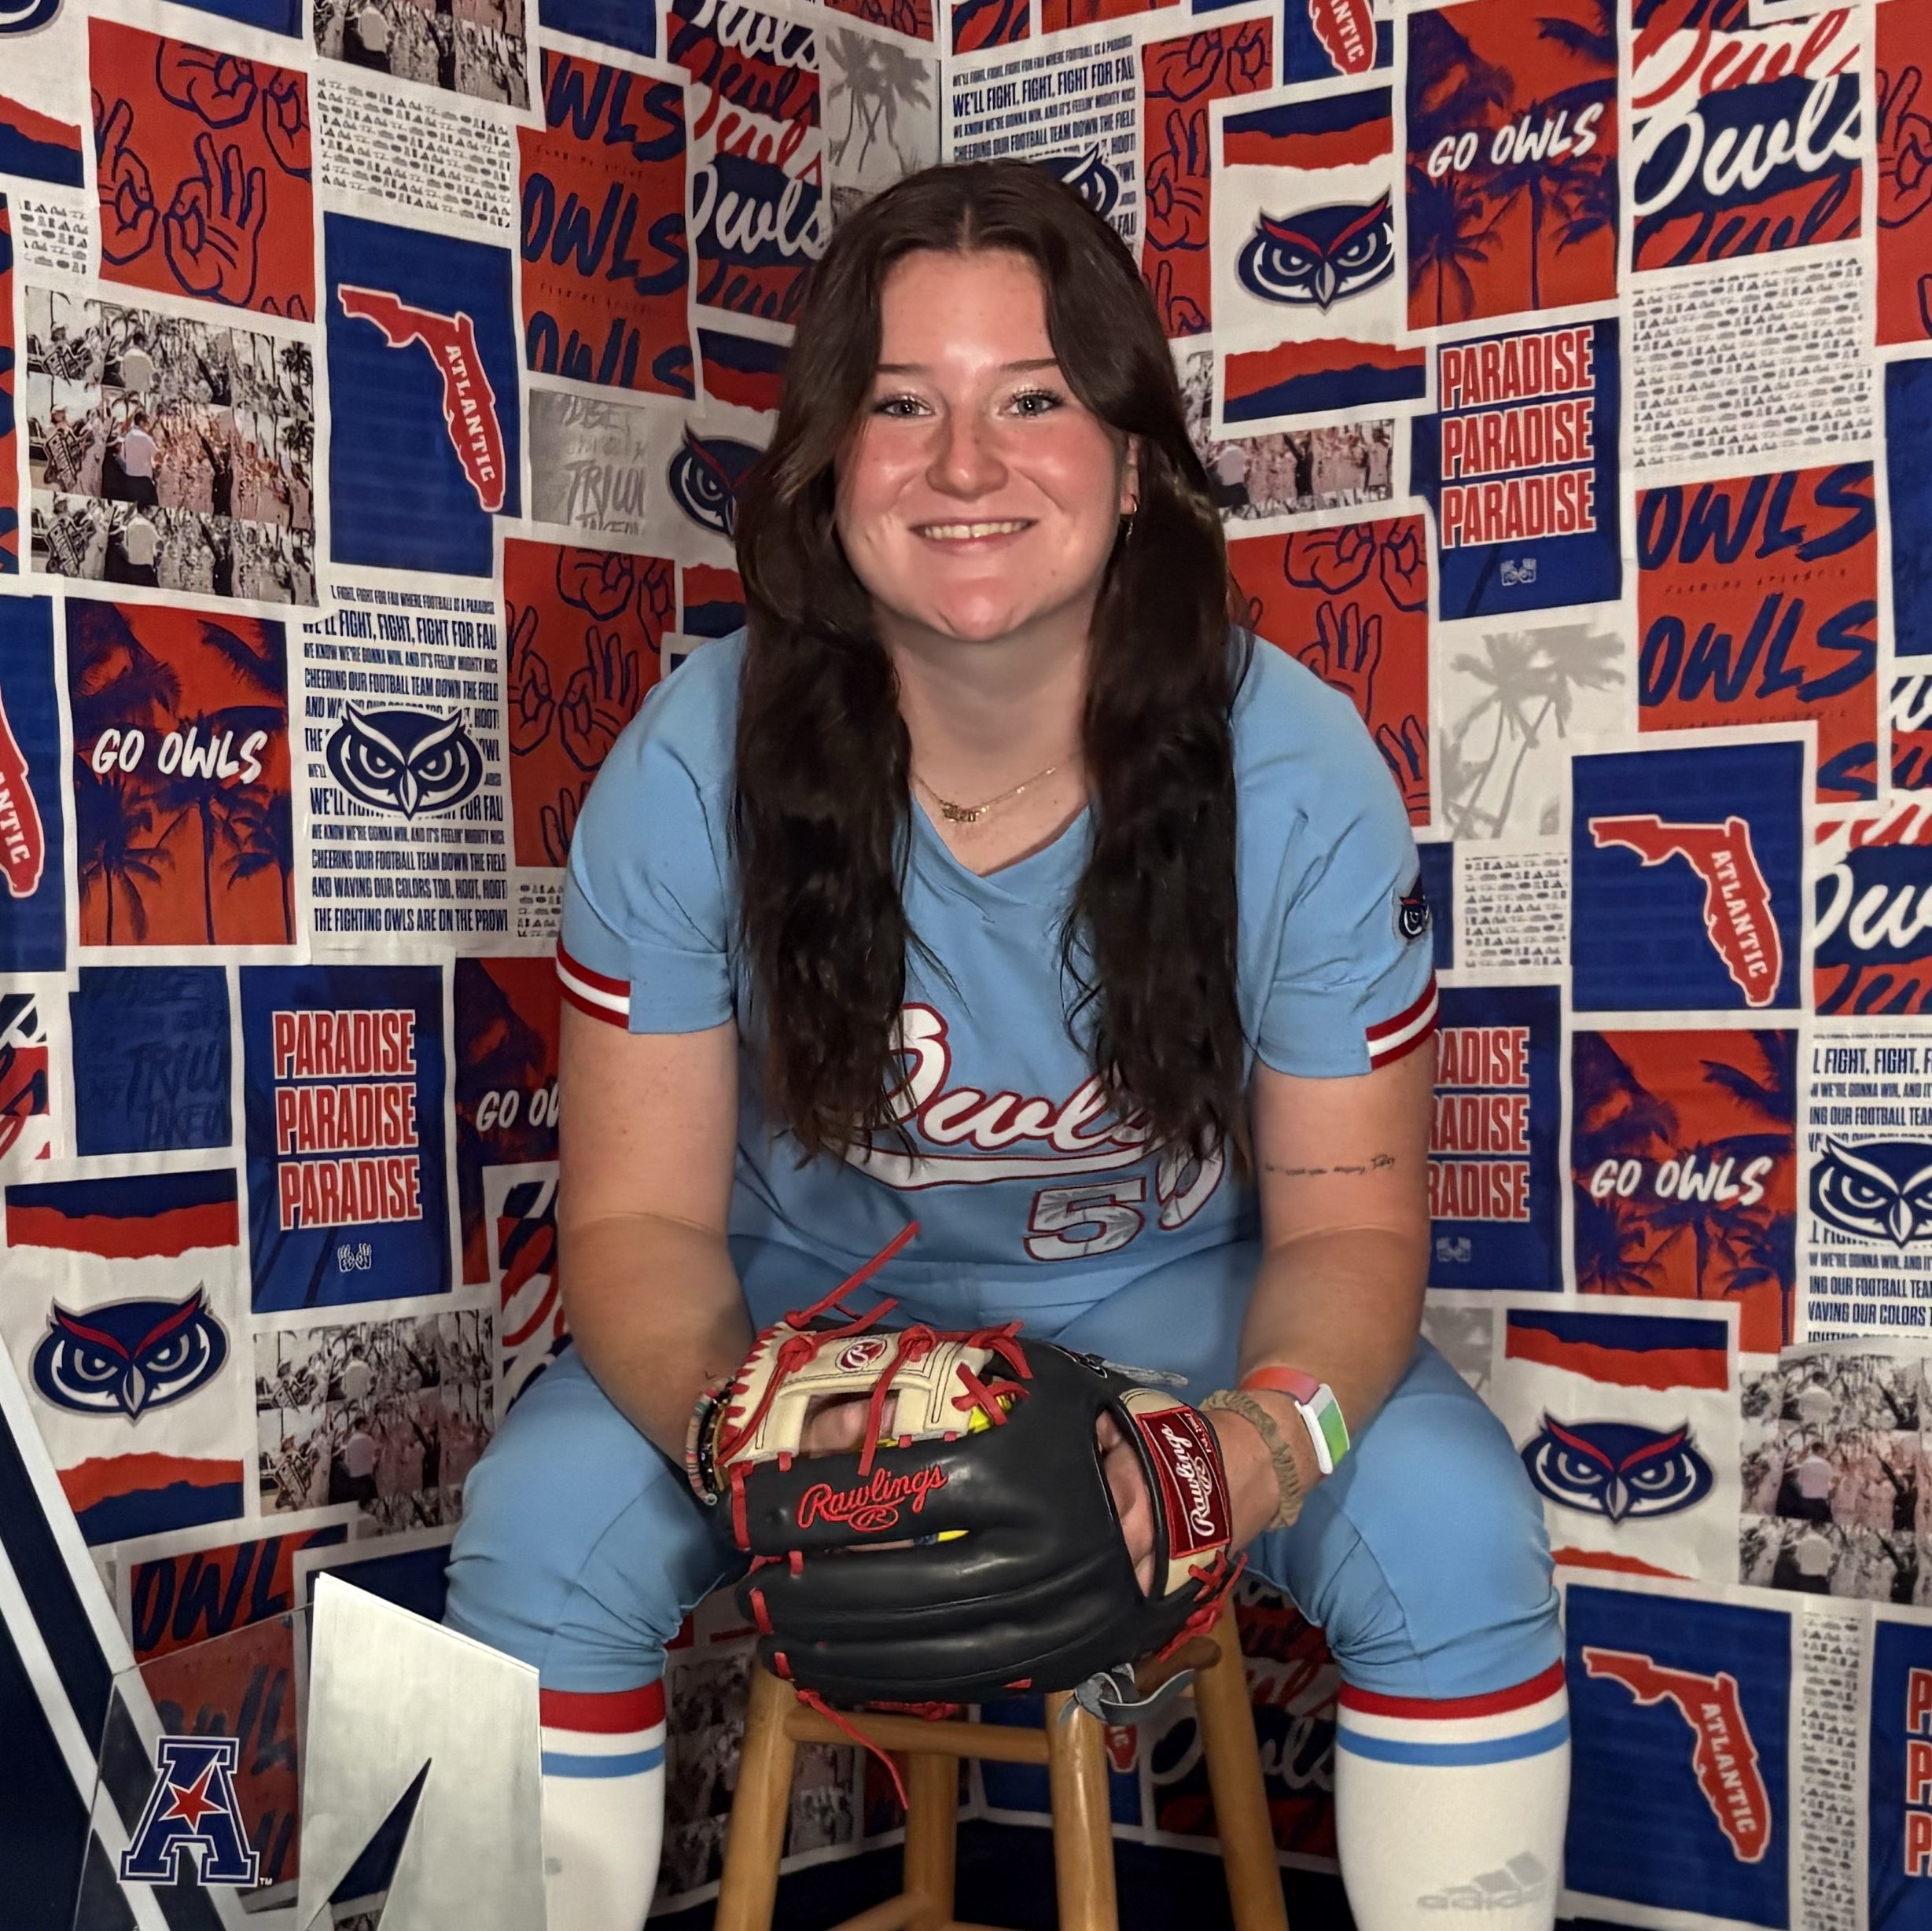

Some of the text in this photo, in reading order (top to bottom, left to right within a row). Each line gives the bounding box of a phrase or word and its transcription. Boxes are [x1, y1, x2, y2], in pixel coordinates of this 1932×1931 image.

[953, 90, 984, 117] WE'LL
[1058, 66, 1089, 95] FIGHT
[1092, 60, 1113, 89] FOR
[1116, 54, 1135, 84] FAU
[1010, 127, 1048, 152] FOOTBALL
[1050, 123, 1072, 147] TEAM
[1428, 102, 1604, 178] GO OWLS
[521, 172, 689, 297] OWLS
[1441, 326, 1595, 410] PARADISE
[445, 343, 496, 483] ATLANTIC
[1441, 397, 1595, 480] PARADISE
[1441, 469, 1596, 549] PARADISE
[1636, 462, 1877, 570] OWLS
[339, 609, 497, 650] FIGHT, FIGHT, FIGHT FOR FAU
[1637, 592, 1878, 707] OWLS
[305, 668, 347, 690] CHEERING
[348, 671, 367, 692] OUR
[370, 673, 410, 695] FOOTBALL
[411, 676, 433, 697] TEAM
[436, 679, 461, 699] DOWN
[463, 680, 477, 700] THE
[305, 696, 325, 718] AND
[91, 726, 268, 785] GO OWLS
[305, 728, 322, 752] THE
[310, 787, 344, 816] WE'LL
[484, 794, 503, 821] FAU
[312, 849, 353, 869] CHEERING
[355, 850, 374, 870] OUR
[375, 851, 415, 870] FOOTBALL
[417, 851, 440, 871] TEAM
[442, 852, 469, 871] DOWN
[470, 853, 484, 871] THE
[312, 877, 331, 897] AND
[333, 877, 372, 898] WAVING
[374, 877, 393, 898] OUR
[396, 877, 431, 899] COLORS
[315, 908, 332, 932] THE
[335, 908, 381, 932] FIGHTING
[385, 908, 414, 932] OWLS
[417, 908, 436, 932] ARE
[440, 909, 453, 932] ON
[455, 909, 473, 932] THE
[1712, 850, 1766, 979] ATLANTIC
[271, 1009, 417, 1080] PARADISE
[1433, 1026, 1530, 1088] ADISE
[274, 1081, 419, 1156] PARADISE
[476, 1090, 520, 1132] GO
[1831, 1106, 1853, 1125] OUR
[1855, 1107, 1906, 1126] FOOTBALL
[278, 1156, 422, 1231] PARADISE
[1591, 1155, 1772, 1206] GO OWLS
[1831, 1276, 1853, 1296] OUR
[1856, 1278, 1908, 1298] FOOTBALL
[1853, 1303, 1876, 1324] OUR
[1880, 1304, 1926, 1326] COLORS
[797, 1465, 948, 1528] Rawlings
[1162, 1422, 1215, 1536] Rawlings
[131, 1533, 291, 1653] OWL
[1701, 1701, 1757, 1834] ATLANTIC
